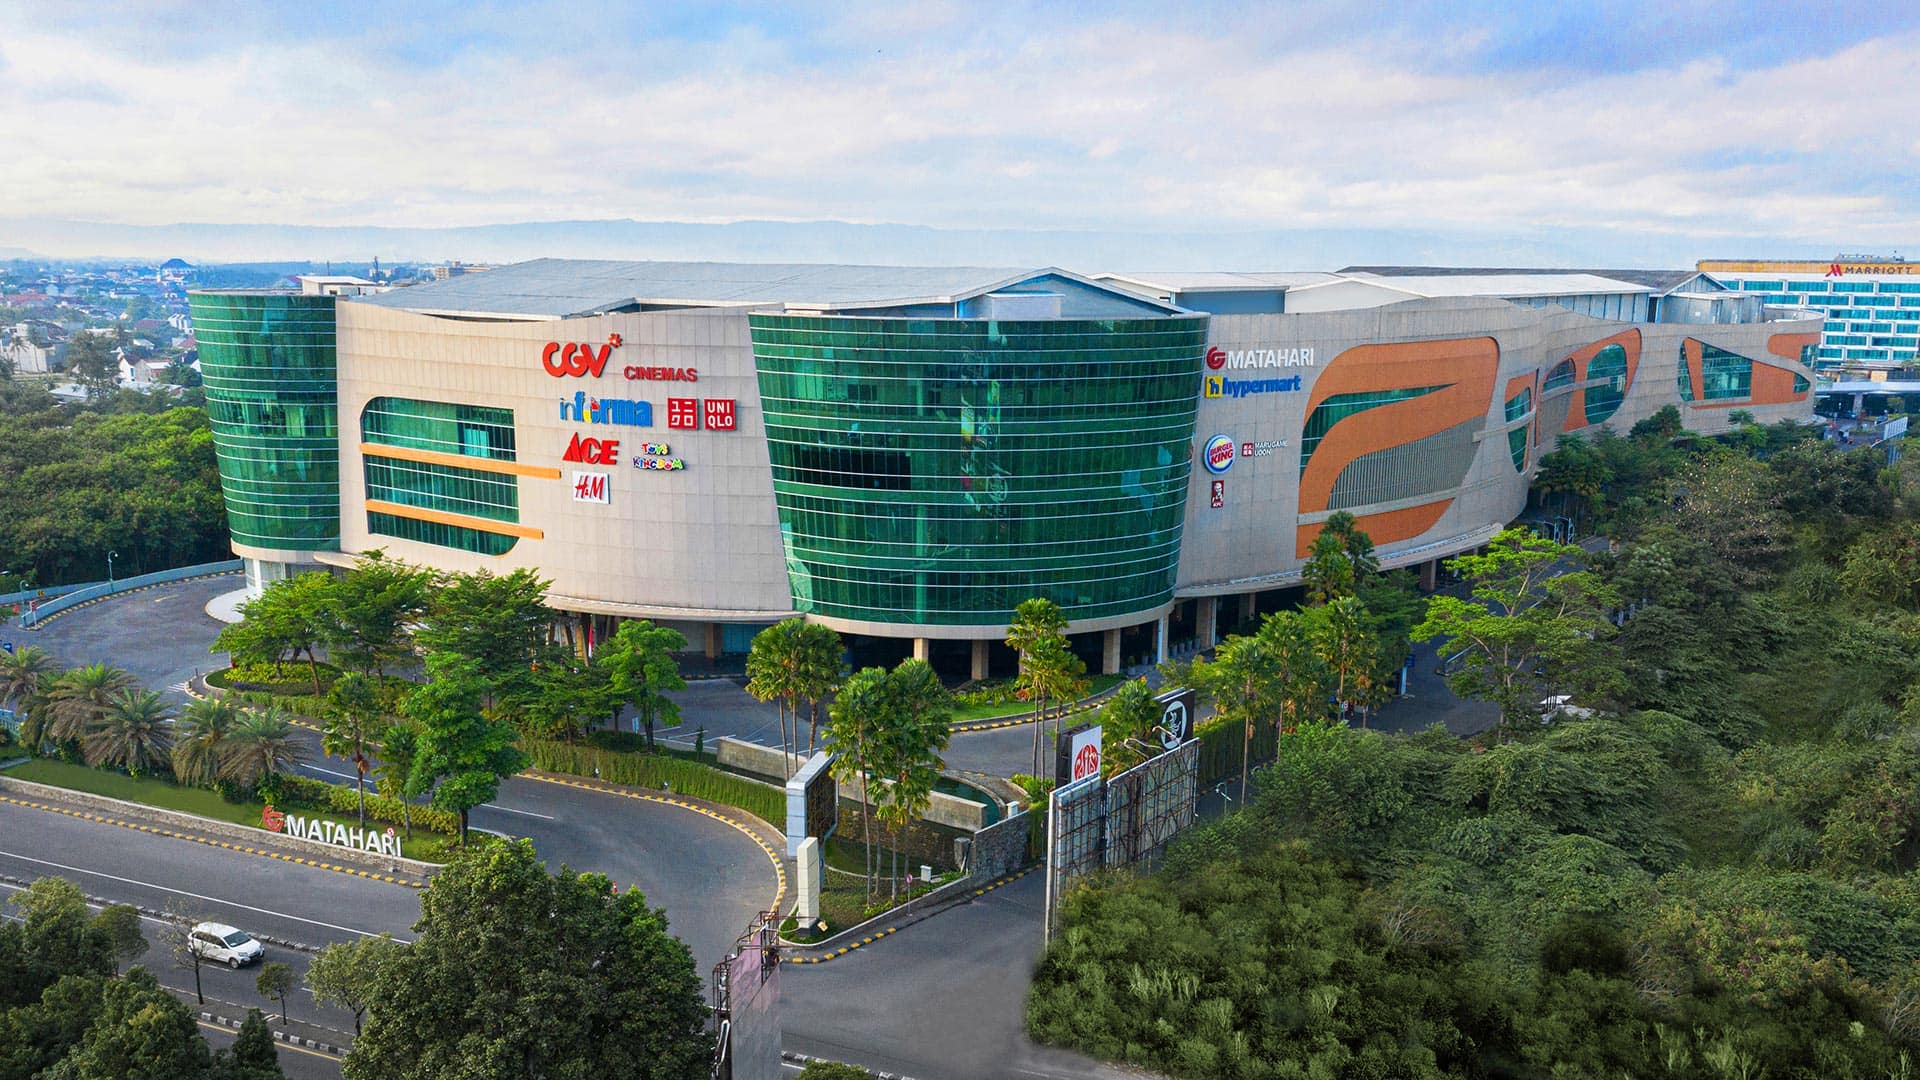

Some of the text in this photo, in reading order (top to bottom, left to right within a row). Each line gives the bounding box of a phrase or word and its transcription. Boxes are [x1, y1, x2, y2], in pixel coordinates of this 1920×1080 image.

[1845, 266, 1912, 274] MARRIOTT
[542, 341, 698, 382] CGV CINEMAS
[1227, 347, 1314, 369] MATAHARI
[1222, 375, 1302, 398] hypermart
[559, 390, 653, 427] informa
[561, 431, 620, 465] ACE
[641, 442, 668, 455] TOYS
[1209, 442, 1233, 456] BURGER
[1210, 449, 1233, 465] KING
[286, 814, 402, 857] MATAHARI
